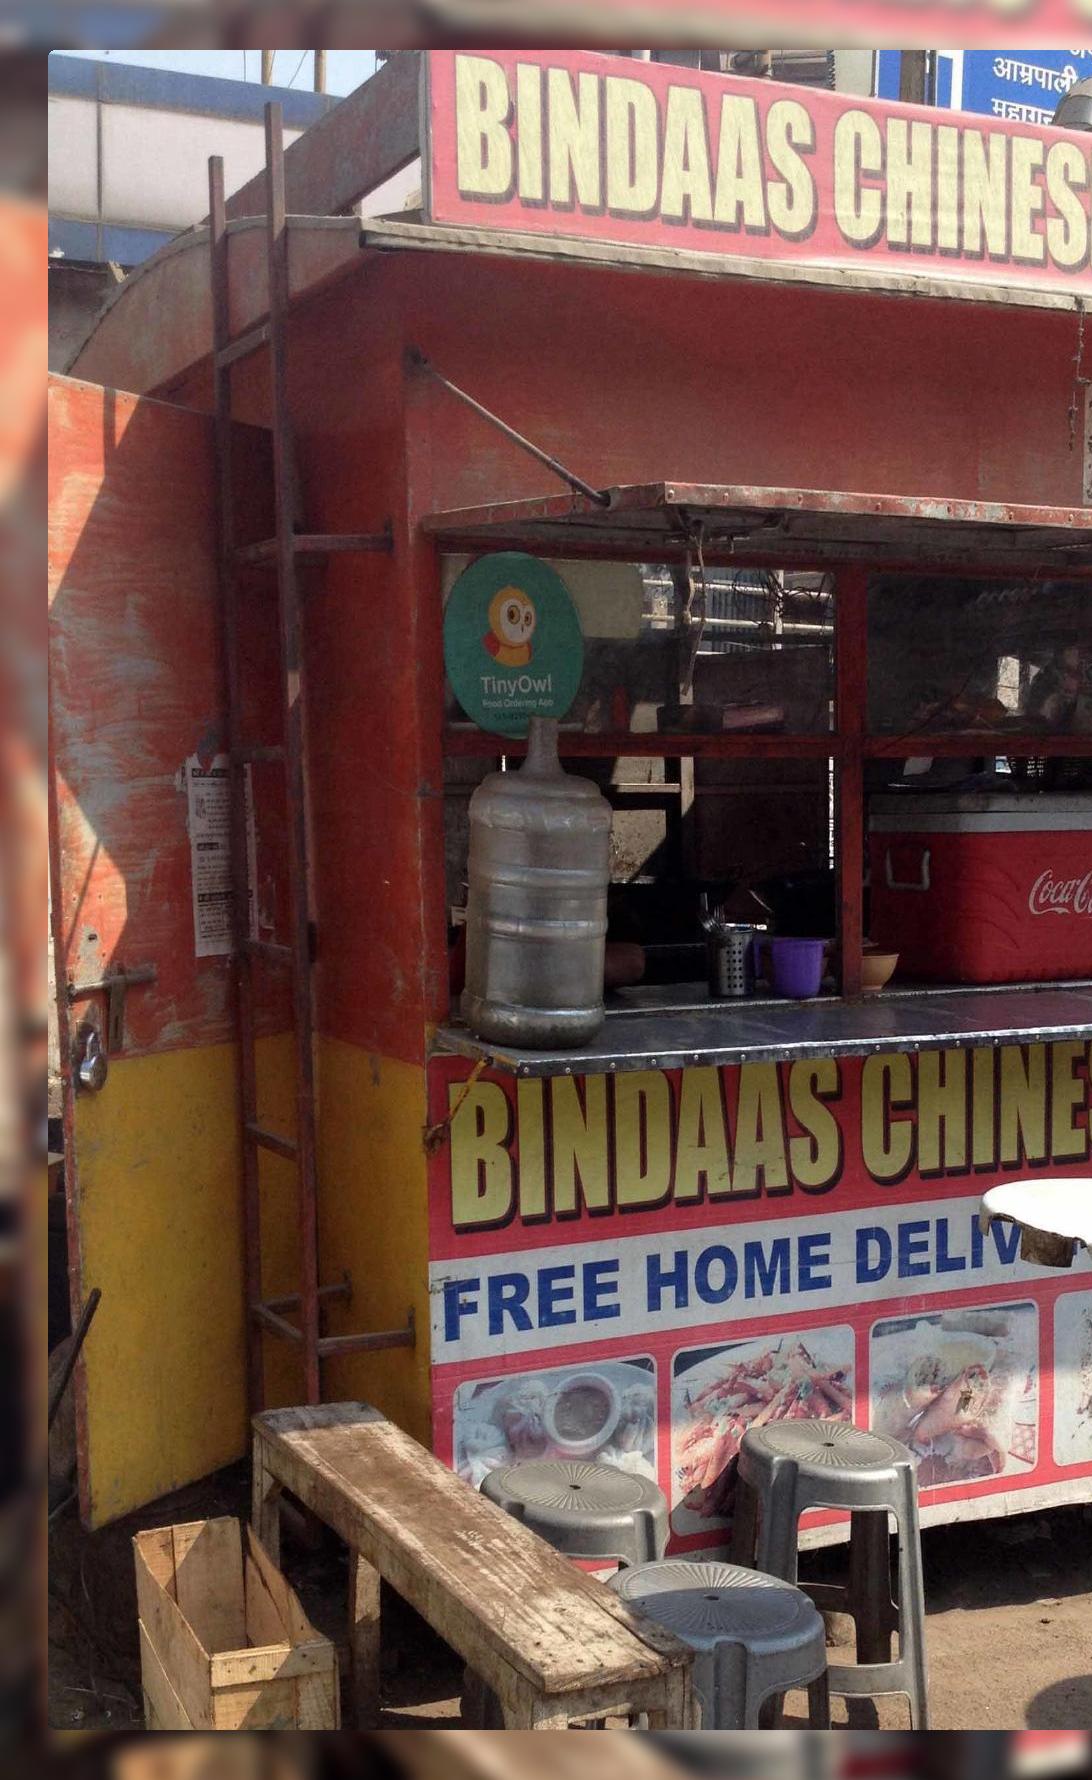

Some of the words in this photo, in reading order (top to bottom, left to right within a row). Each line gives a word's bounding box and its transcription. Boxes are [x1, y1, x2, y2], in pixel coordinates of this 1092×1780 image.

[455, 55, 815, 239] BINDAAS
[480, 675, 552, 697] TinyOwl
[449, 1058, 841, 1232] BINDAAS
[443, 1259, 621, 1341] FREE
[647, 1232, 832, 1312] HOME
[856, 1213, 1022, 1283] DELIV
